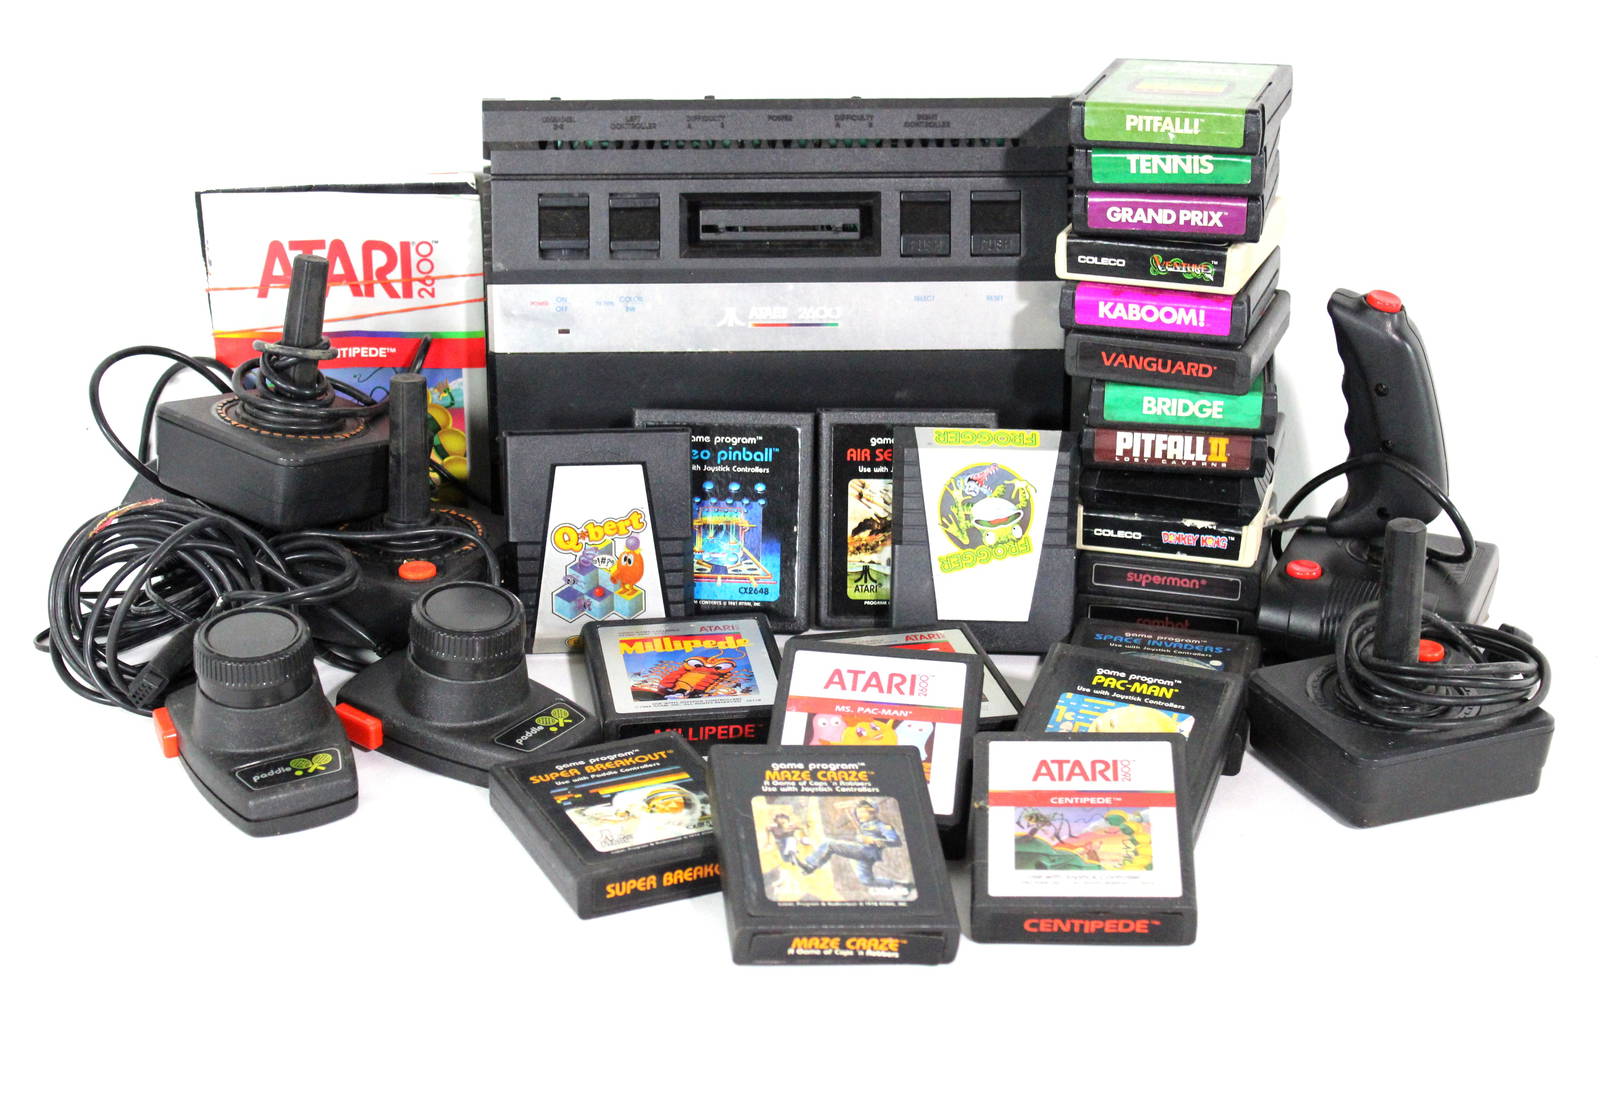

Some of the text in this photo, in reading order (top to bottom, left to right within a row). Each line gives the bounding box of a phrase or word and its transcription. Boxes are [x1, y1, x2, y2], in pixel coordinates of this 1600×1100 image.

[834, 114, 874, 122] DIFFICULTY
[1126, 155, 1215, 174] TENNIS
[1106, 206, 1176, 225] GRAND
[415, 241, 435, 299] 2600
[1077, 255, 1126, 267] COLECO
[1098, 301, 1205, 327] KABOOM!
[1142, 396, 1225, 419] BRIDGE
[846, 448, 871, 461] AIR
[1115, 431, 1229, 463] PITFALL II
[703, 464, 730, 473] Joystick
[732, 465, 770, 473] Controllers
[1161, 459, 1227, 468] CAVERNS
[1093, 528, 1142, 540] COLECO
[1161, 531, 1198, 547] DONKEY
[739, 586, 769, 596] CX2648
[854, 584, 878, 593] ATARI
[700, 624, 734, 633] ATARI
[904, 632, 942, 642] ATARI
[618, 635, 752, 655] Millipede
[1094, 633, 1224, 653] SPACE INVADERS
[1096, 667, 1127, 678] game
[823, 668, 917, 696] ATARI
[918, 674, 929, 696] 2600
[1076, 685, 1185, 710] Use with Joystick Controllers
[835, 705, 853, 713] MS.
[516, 725, 545, 746] paddle
[252, 766, 292, 783] paddle
[555, 760, 586, 771] game
[572, 775, 590, 783] with
[591, 770, 618, 779] Paddle
[620, 762, 660, 773] Controllers
[771, 762, 805, 771] game
[1032, 759, 1118, 782] ATARI
[1120, 759, 1131, 782] 2600
[529, 767, 581, 785] SUPER
[764, 769, 812, 782] MAZE
[800, 786, 833, 794] Joystick
[605, 875, 657, 899] SUPER
[790, 936, 841, 950] MAZE
